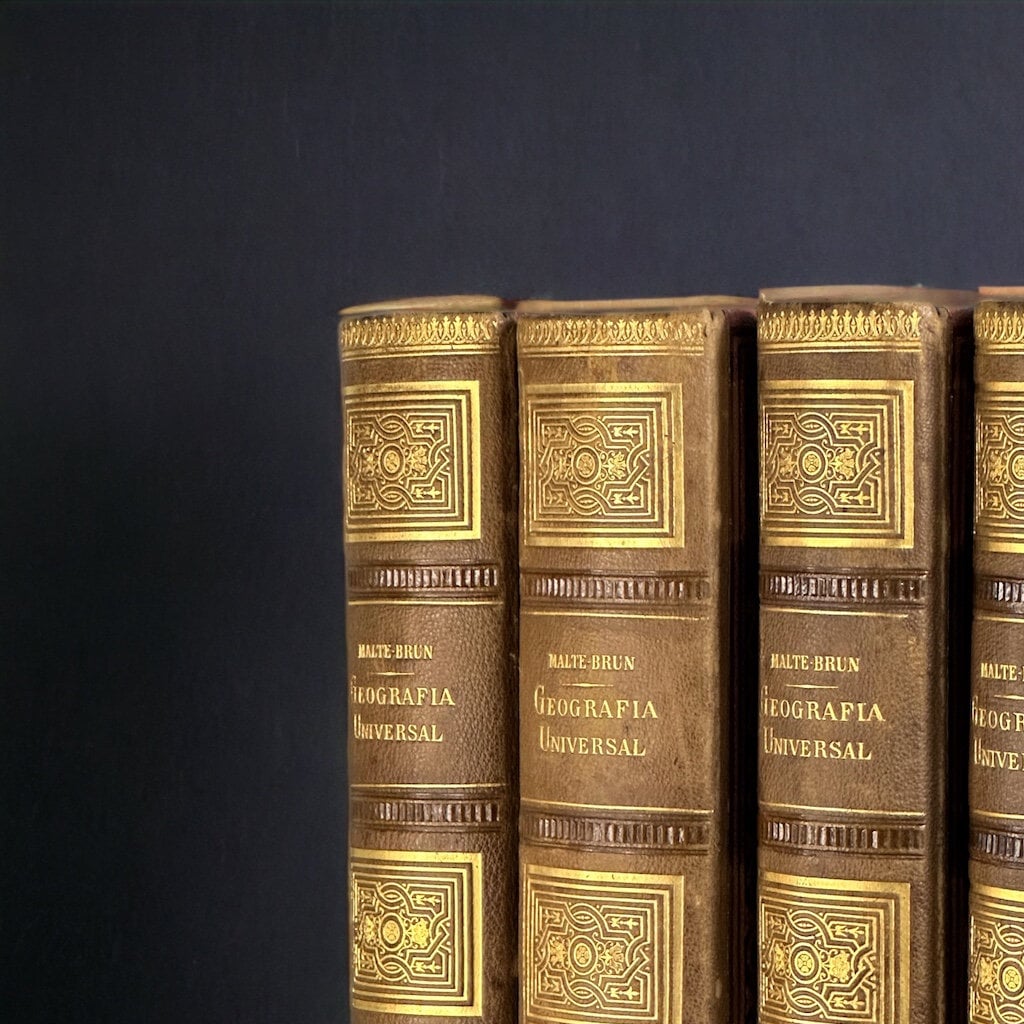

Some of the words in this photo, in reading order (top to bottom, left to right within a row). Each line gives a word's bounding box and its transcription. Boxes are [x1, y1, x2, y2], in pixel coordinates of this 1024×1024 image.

[358, 643, 433, 660] MALTE-BRUN
[548, 653, 636, 671] MALTE-BRUN
[770, 653, 861, 673] MALTE-BRUN
[534, 684, 659, 719] GEOGRAFIA
[353, 713, 444, 743] UNIVERSAL
[539, 725, 647, 757] UNIVERSAL
[763, 725, 873, 761] UNIVERSAL
